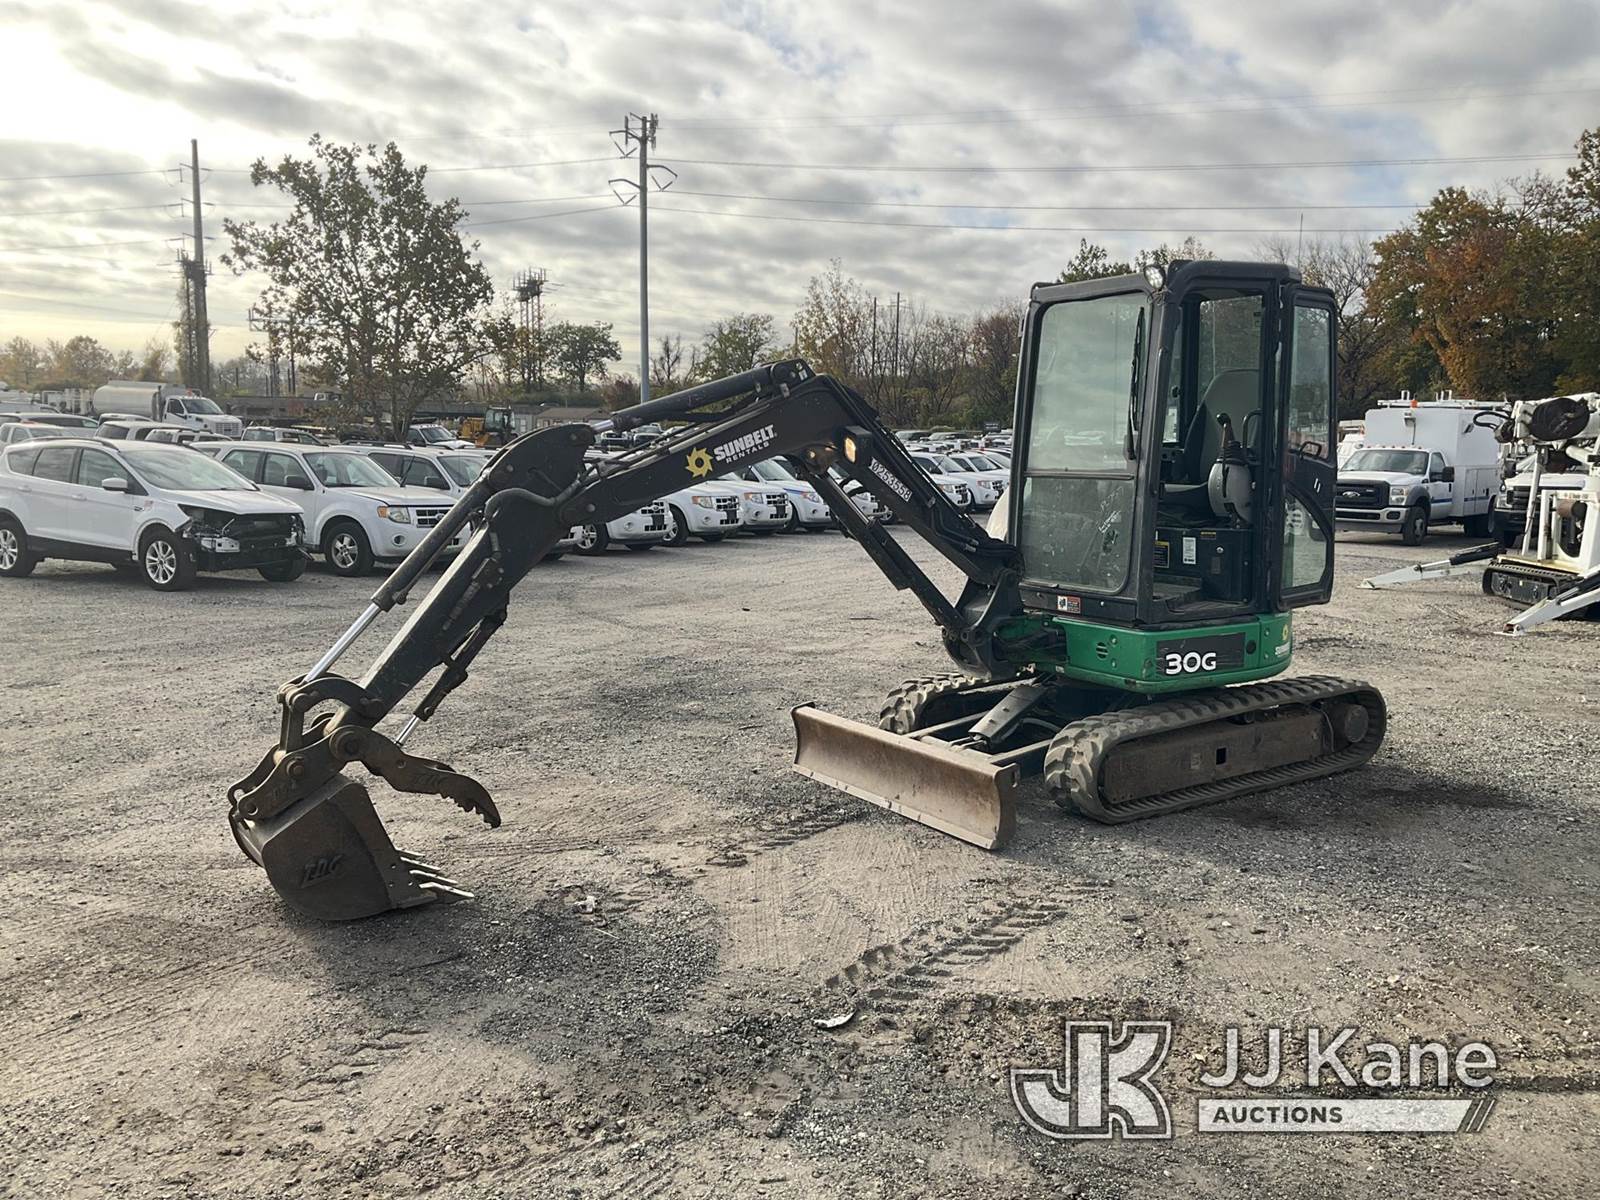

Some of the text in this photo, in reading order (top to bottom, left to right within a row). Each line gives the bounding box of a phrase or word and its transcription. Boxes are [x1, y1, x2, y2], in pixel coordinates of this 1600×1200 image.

[713, 424, 774, 461] SUNBELT
[726, 441, 769, 463] RENTALS
[1165, 651, 1216, 675] 30G
